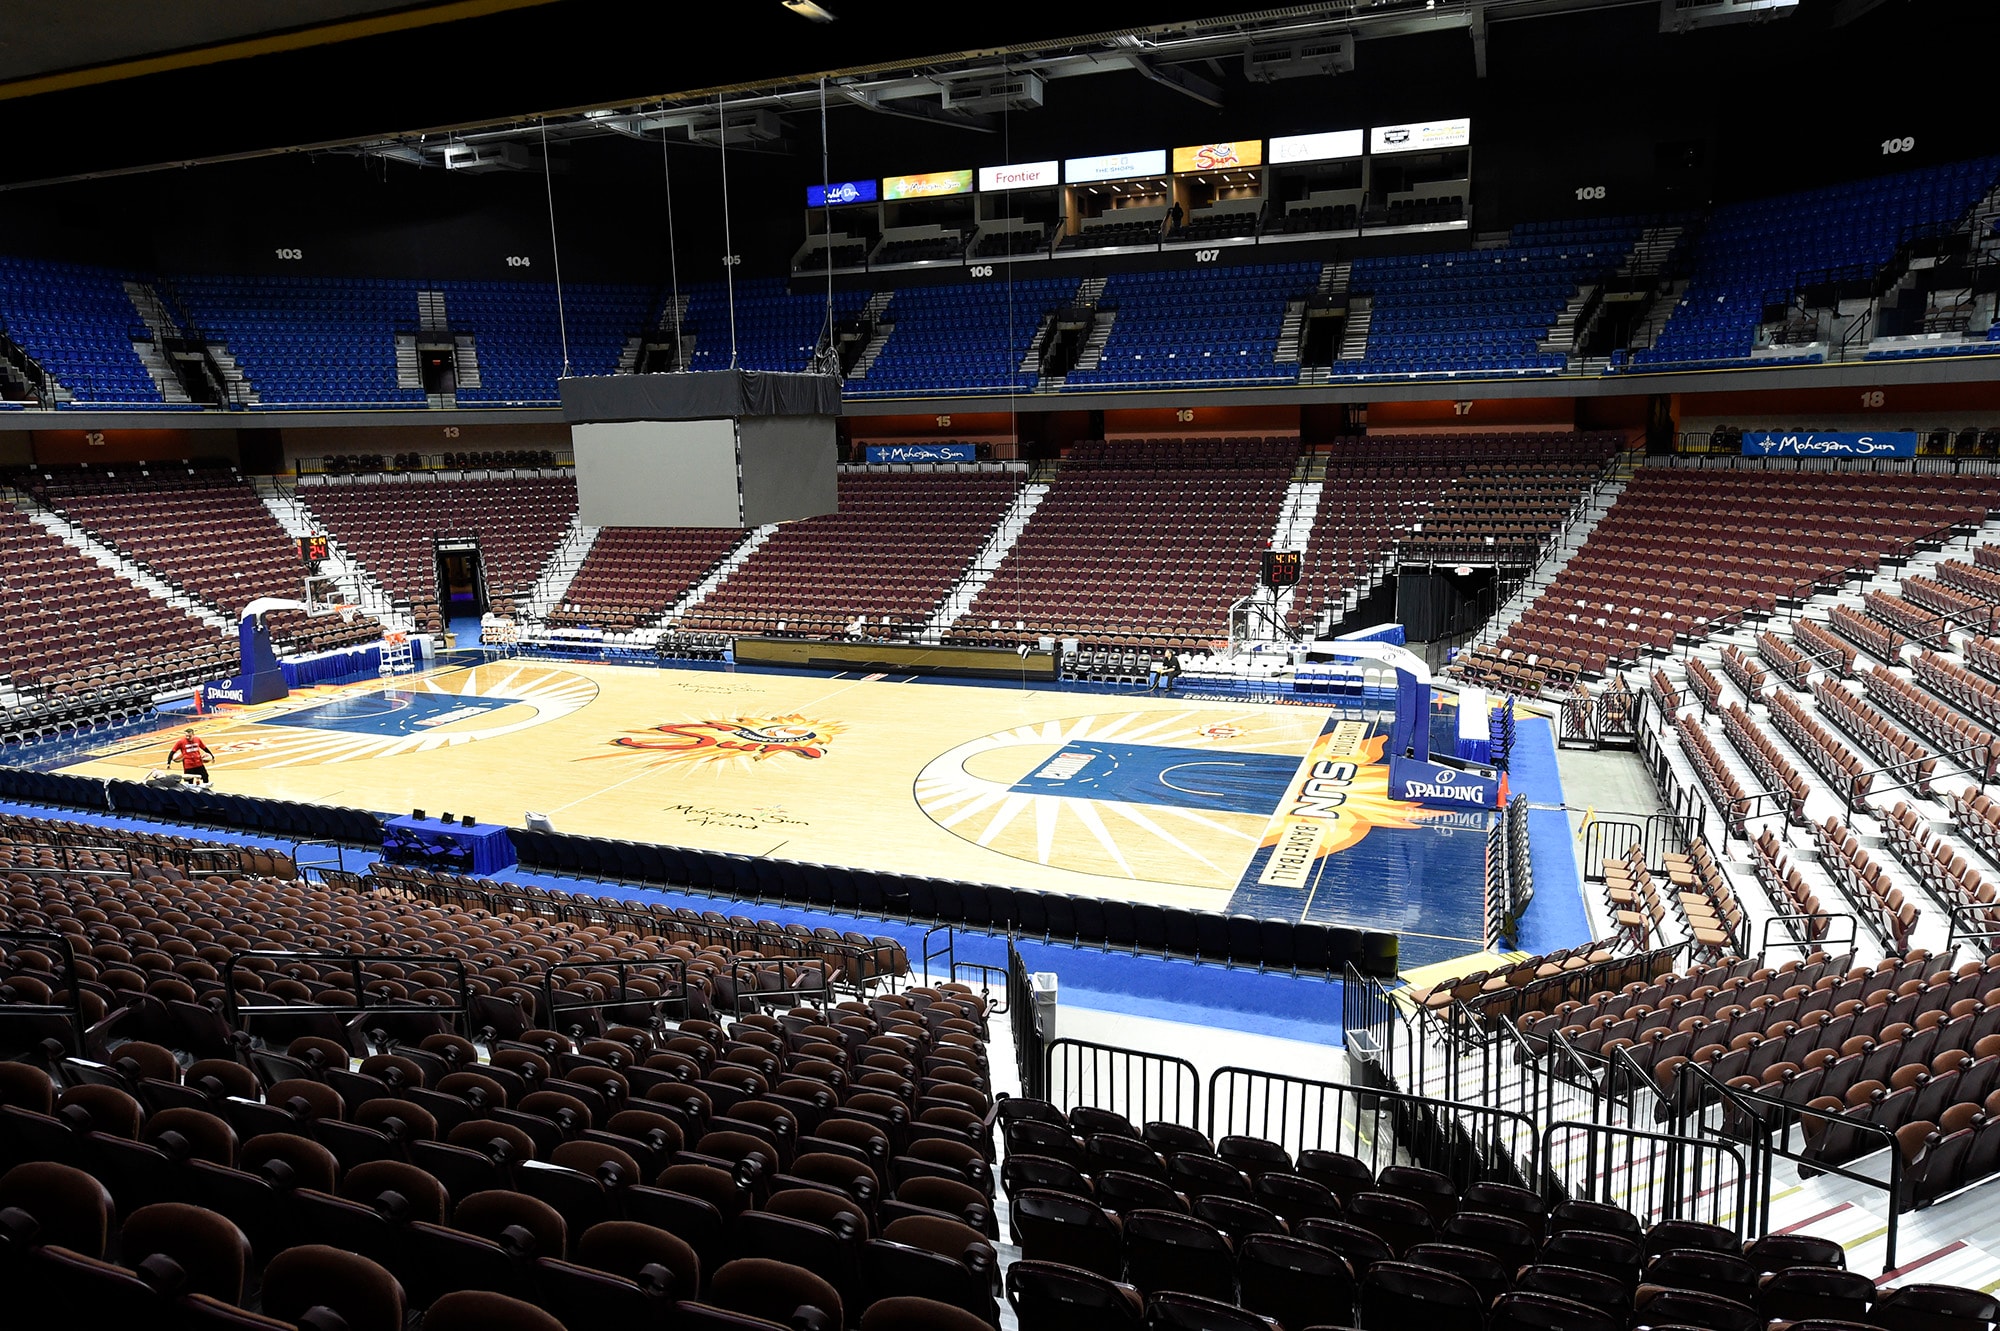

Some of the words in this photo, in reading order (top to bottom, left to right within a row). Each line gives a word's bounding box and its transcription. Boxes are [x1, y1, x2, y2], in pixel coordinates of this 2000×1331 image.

[1881, 136, 1915, 155] 109
[1197, 147, 1238, 168] Sun
[996, 171, 1040, 184] Frontier
[1576, 186, 1606, 201] 108
[275, 248, 303, 260] 103
[722, 255, 741, 266] 105
[1195, 249, 1220, 262] 107
[505, 256, 531, 267] 104
[970, 265, 993, 278] 106
[1861, 391, 1885, 408] 18
[1453, 401, 1473, 415] 17
[936, 415, 951, 427] 15
[1176, 409, 1194, 422] 16
[86, 433, 105, 445] 12
[443, 427, 460, 438] 13
[1778, 435, 1854, 454] Mohegan
[1856, 437, 1896, 454] Sun
[891, 447, 939, 460] Mohegan
[940, 447, 964, 460] Sun
[309, 545, 327, 560] 24
[1275, 554, 1298, 564] 4:14
[1272, 564, 1295, 582] 24
[207, 687, 243, 702] SPALDING
[616, 722, 827, 760] Sun
[1289, 759, 1359, 820] SUN
[1405, 780, 1485, 804] SPALDING
[1270, 825, 1319, 880] BASKETBALL
